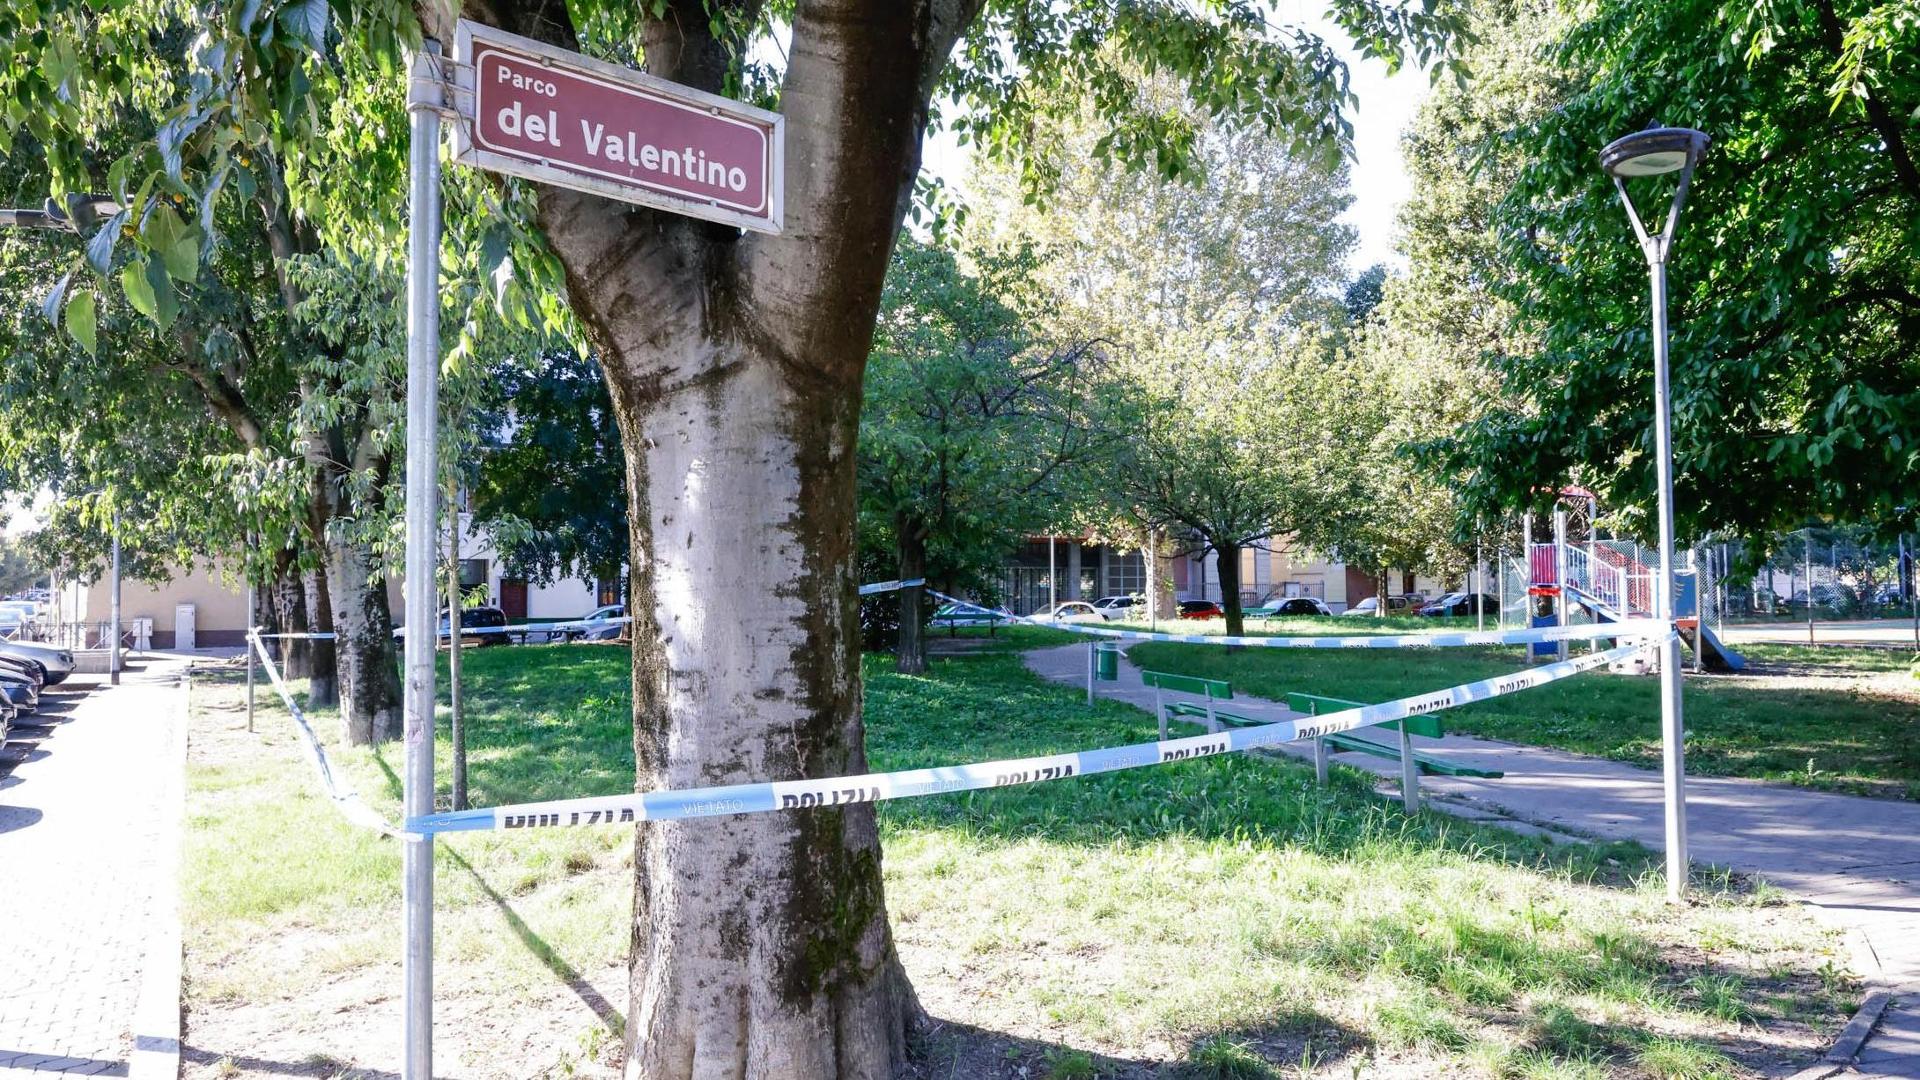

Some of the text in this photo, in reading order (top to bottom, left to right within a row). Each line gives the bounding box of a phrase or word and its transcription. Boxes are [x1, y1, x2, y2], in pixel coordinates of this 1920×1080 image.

[498, 65, 557, 98] Parco
[498, 101, 747, 193] del Valentino
[682, 799, 744, 815] VIETATO
